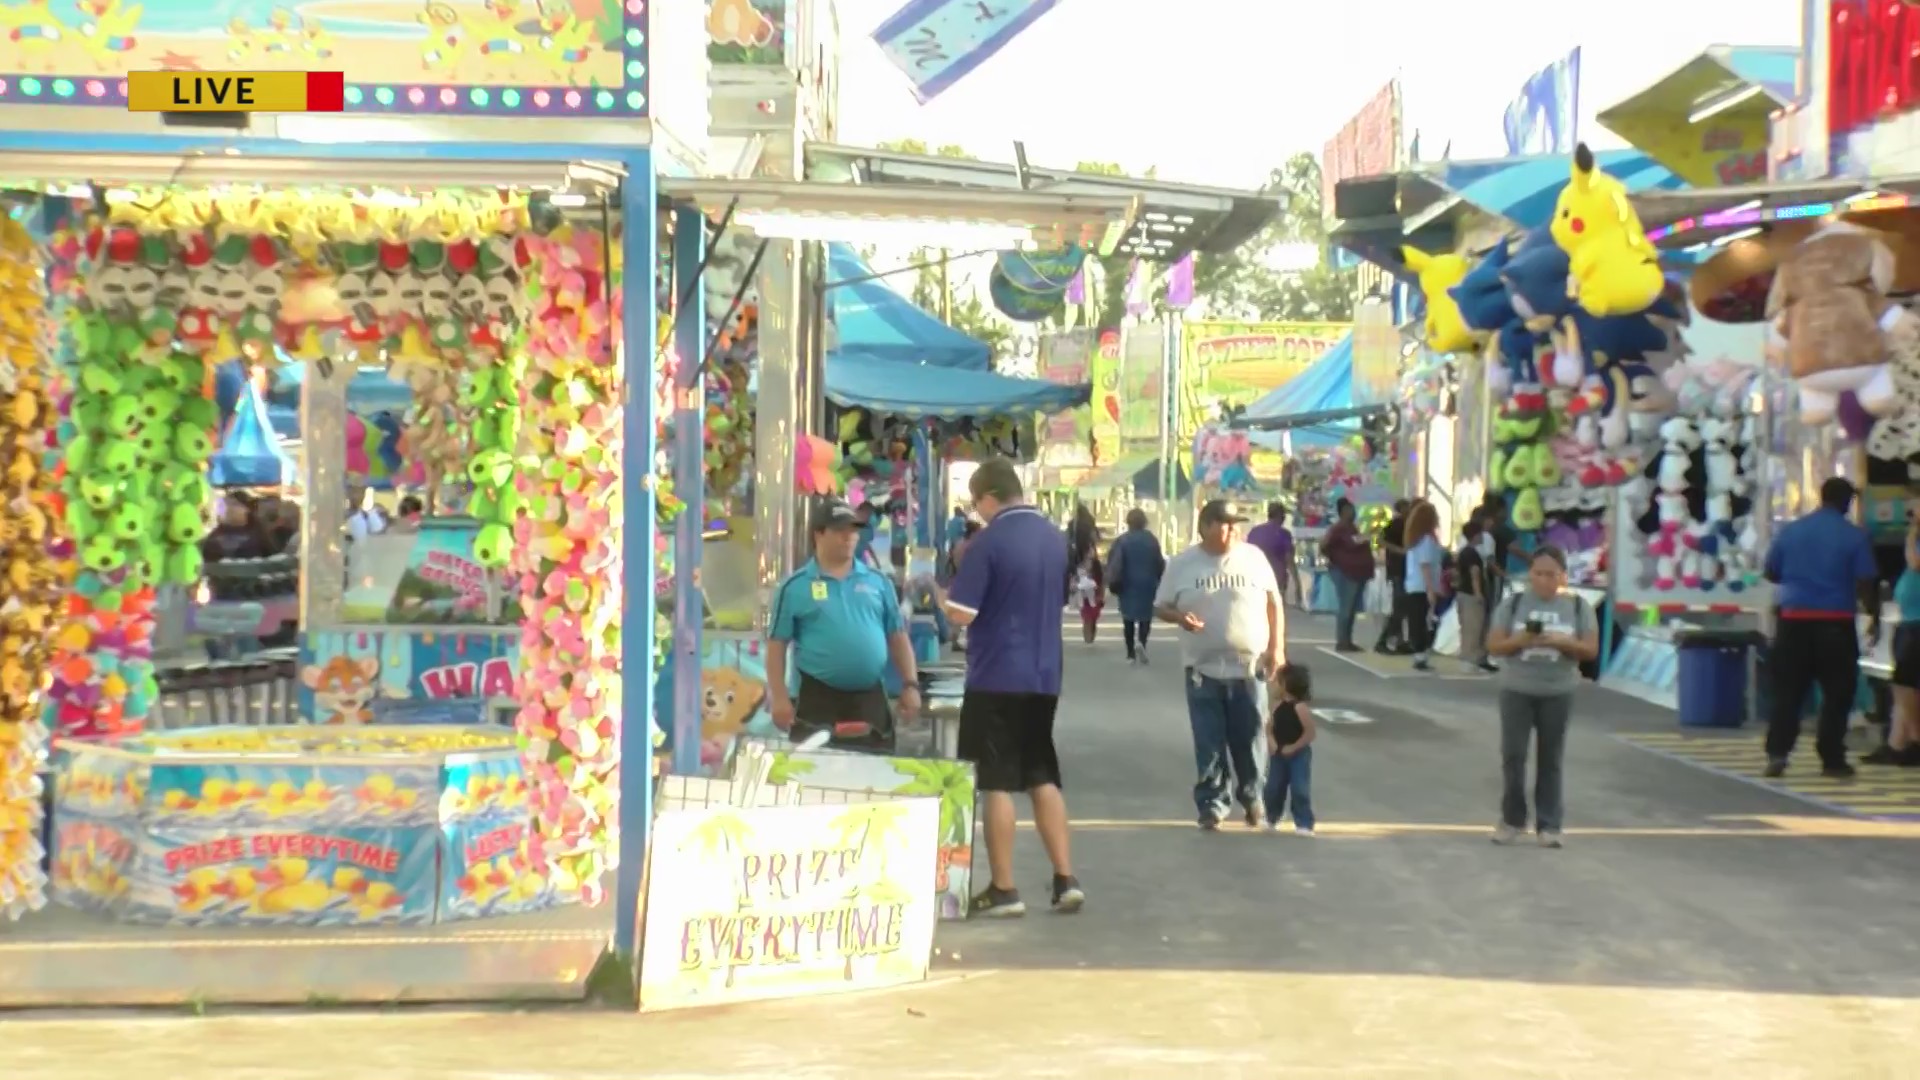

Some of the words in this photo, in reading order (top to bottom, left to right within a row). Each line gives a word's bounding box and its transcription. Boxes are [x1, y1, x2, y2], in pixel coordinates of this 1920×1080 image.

[163, 836, 244, 874] PRIZE
[250, 832, 400, 873] EVERYTIME
[738, 849, 861, 901] PRIZE
[679, 903, 904, 968] EVERYTIME
